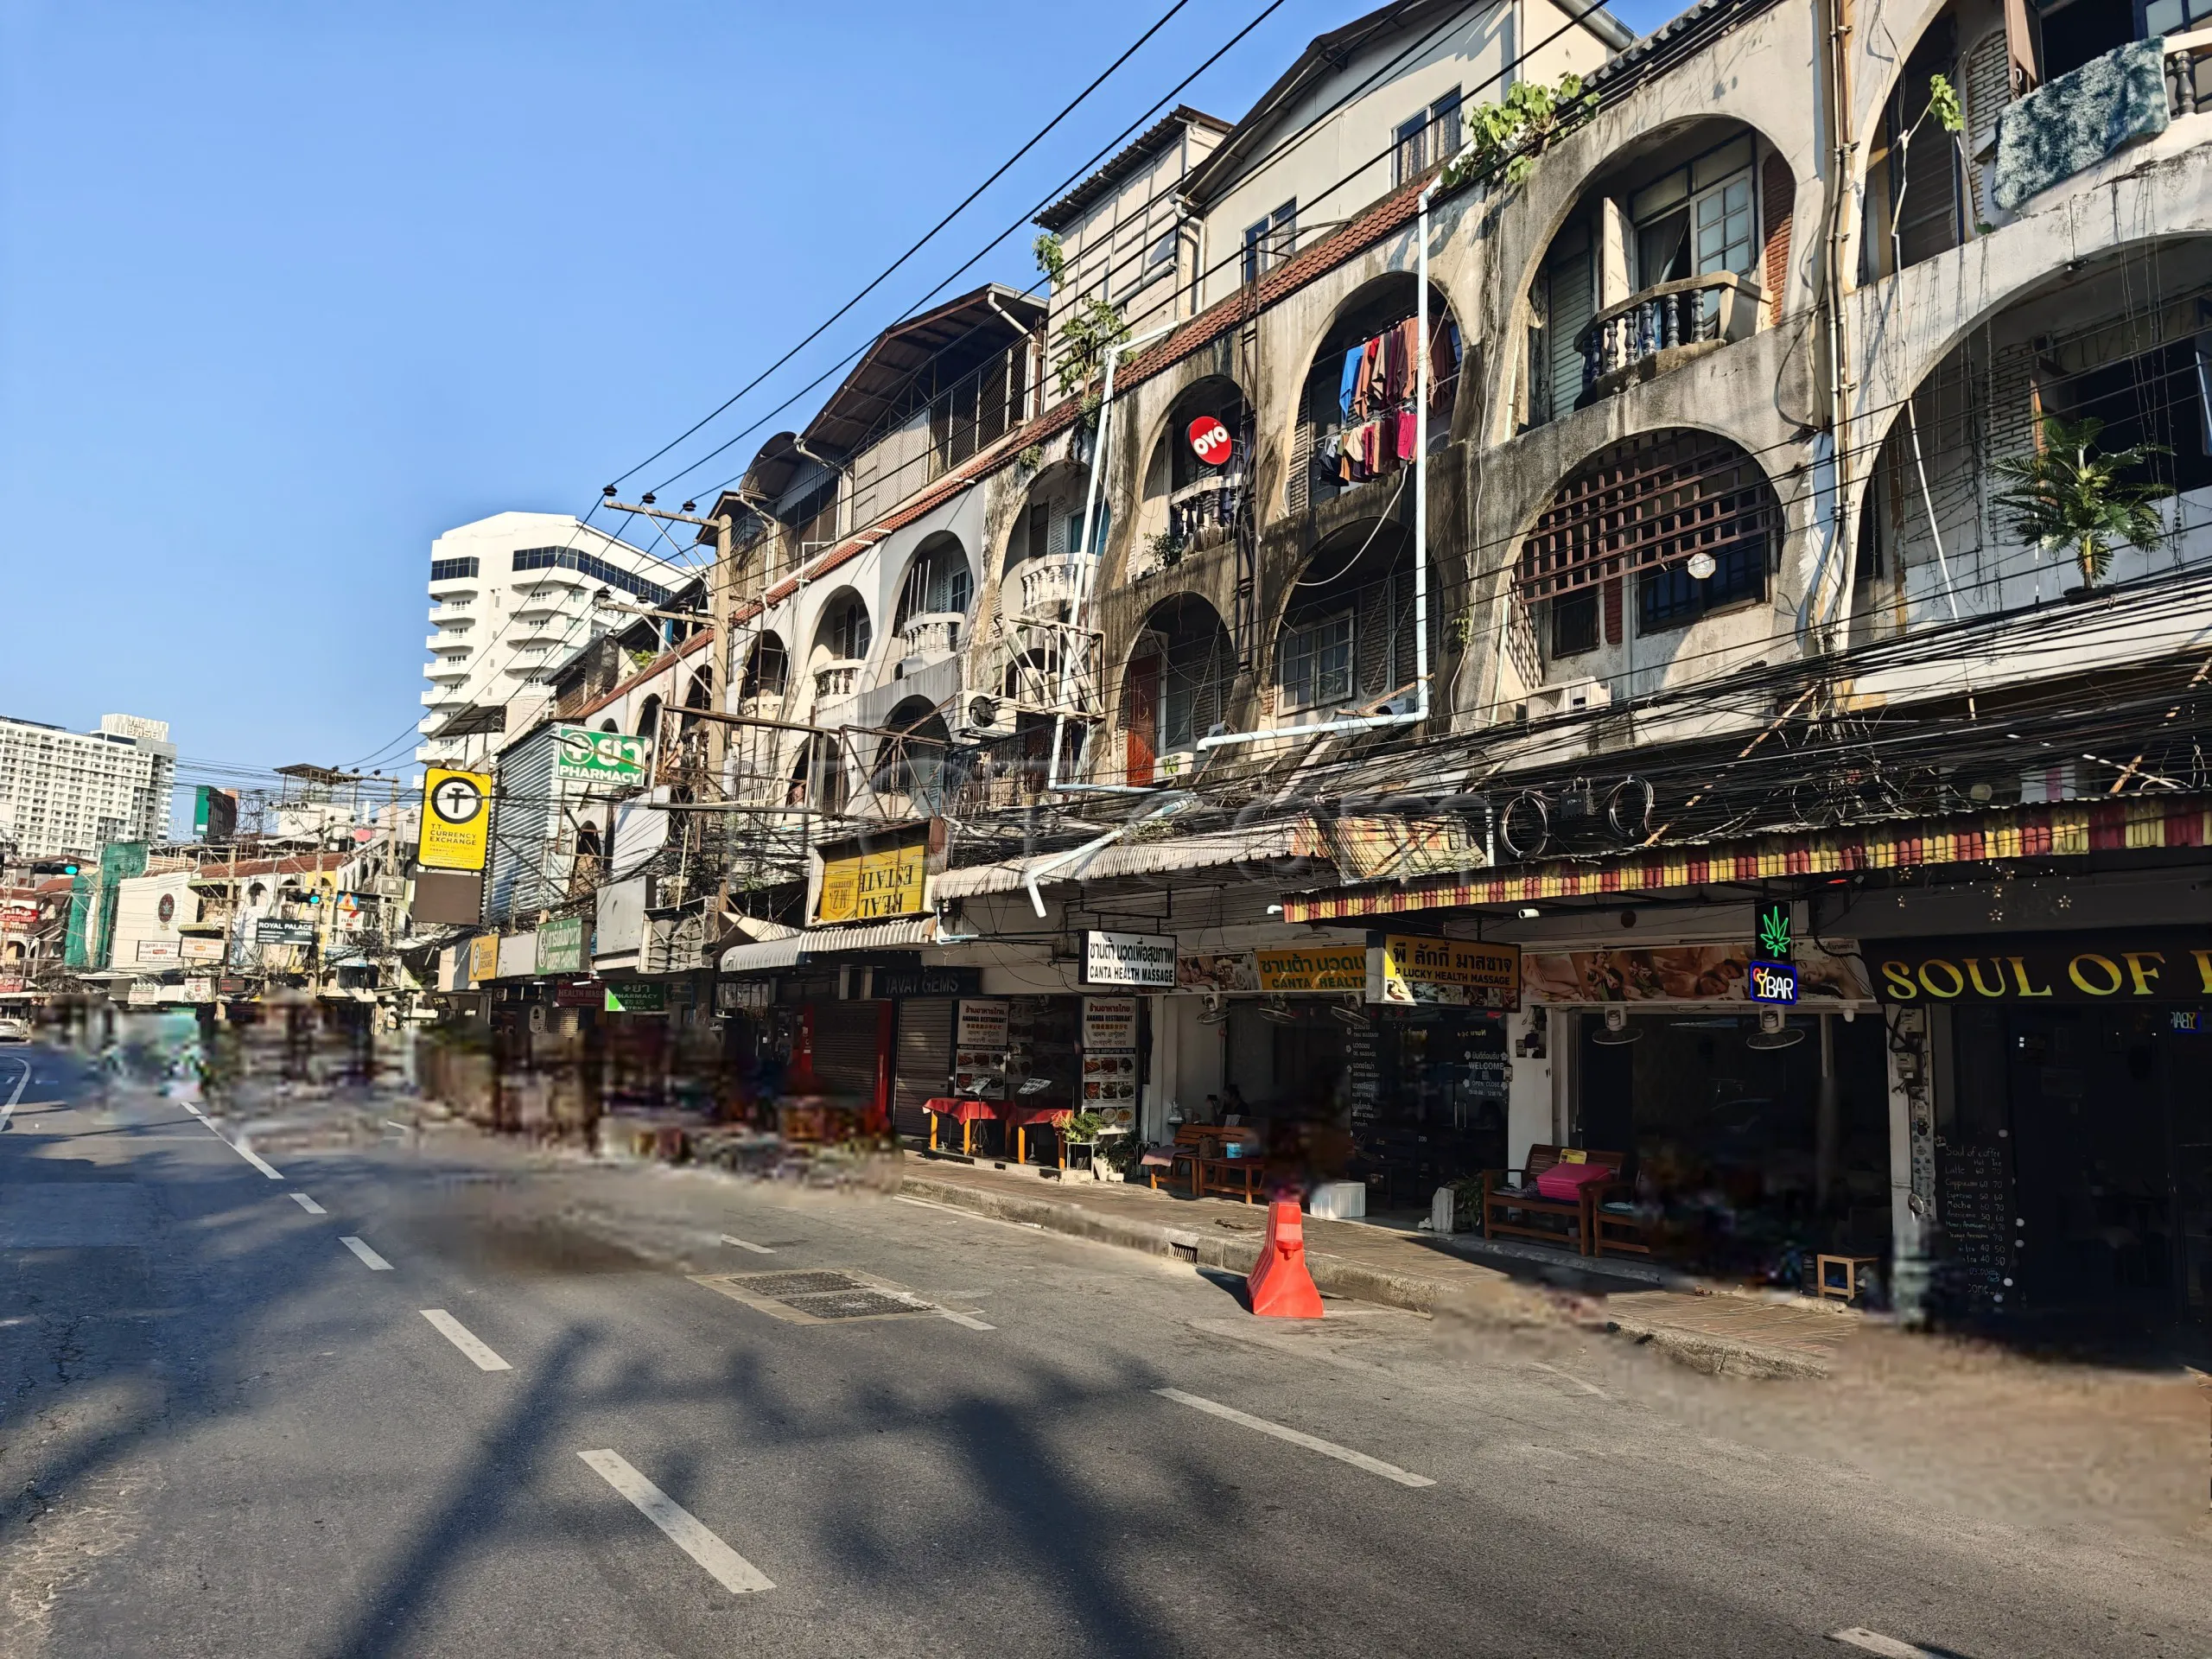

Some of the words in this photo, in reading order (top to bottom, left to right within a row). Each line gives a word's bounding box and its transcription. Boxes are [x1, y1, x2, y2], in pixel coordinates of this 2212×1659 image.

[1193, 426, 1229, 454] OYO
[128, 725, 158, 739] BASE
[597, 739, 644, 769] ยา
[560, 765, 642, 784] PHARMACY
[429, 836, 476, 846] EXCHANGE
[430, 830, 477, 839] CURRENCY
[861, 893, 904, 917] REAL
[284, 923, 314, 931] PALACE
[1090, 966, 1112, 979] CANTA
[1115, 967, 1140, 981] HEALTH
[1142, 969, 1174, 982] MASSAGE
[1403, 969, 1433, 980] LUCKY
[1435, 971, 1468, 983] HEALTH
[1471, 975, 1510, 986] MASSAGE
[1880, 955, 2054, 1001] SOUL
[2068, 950, 2167, 997] OF
[922, 972, 959, 994] GEMS
[1271, 977, 1312, 989] CANTA
[1766, 976, 1794, 1001] BAR
[558, 988, 584, 998] HEALTH
[1468, 1061, 1504, 1071] WELCOME
[1945, 1145, 1965, 1157] Soul
[1967, 1147, 1977, 1158] of
[1945, 1164, 1966, 1174] Latte
[1994, 1203, 2005, 1211] 70
[1980, 1243, 1990, 1252] 40
[1980, 1254, 1990, 1262] 40
